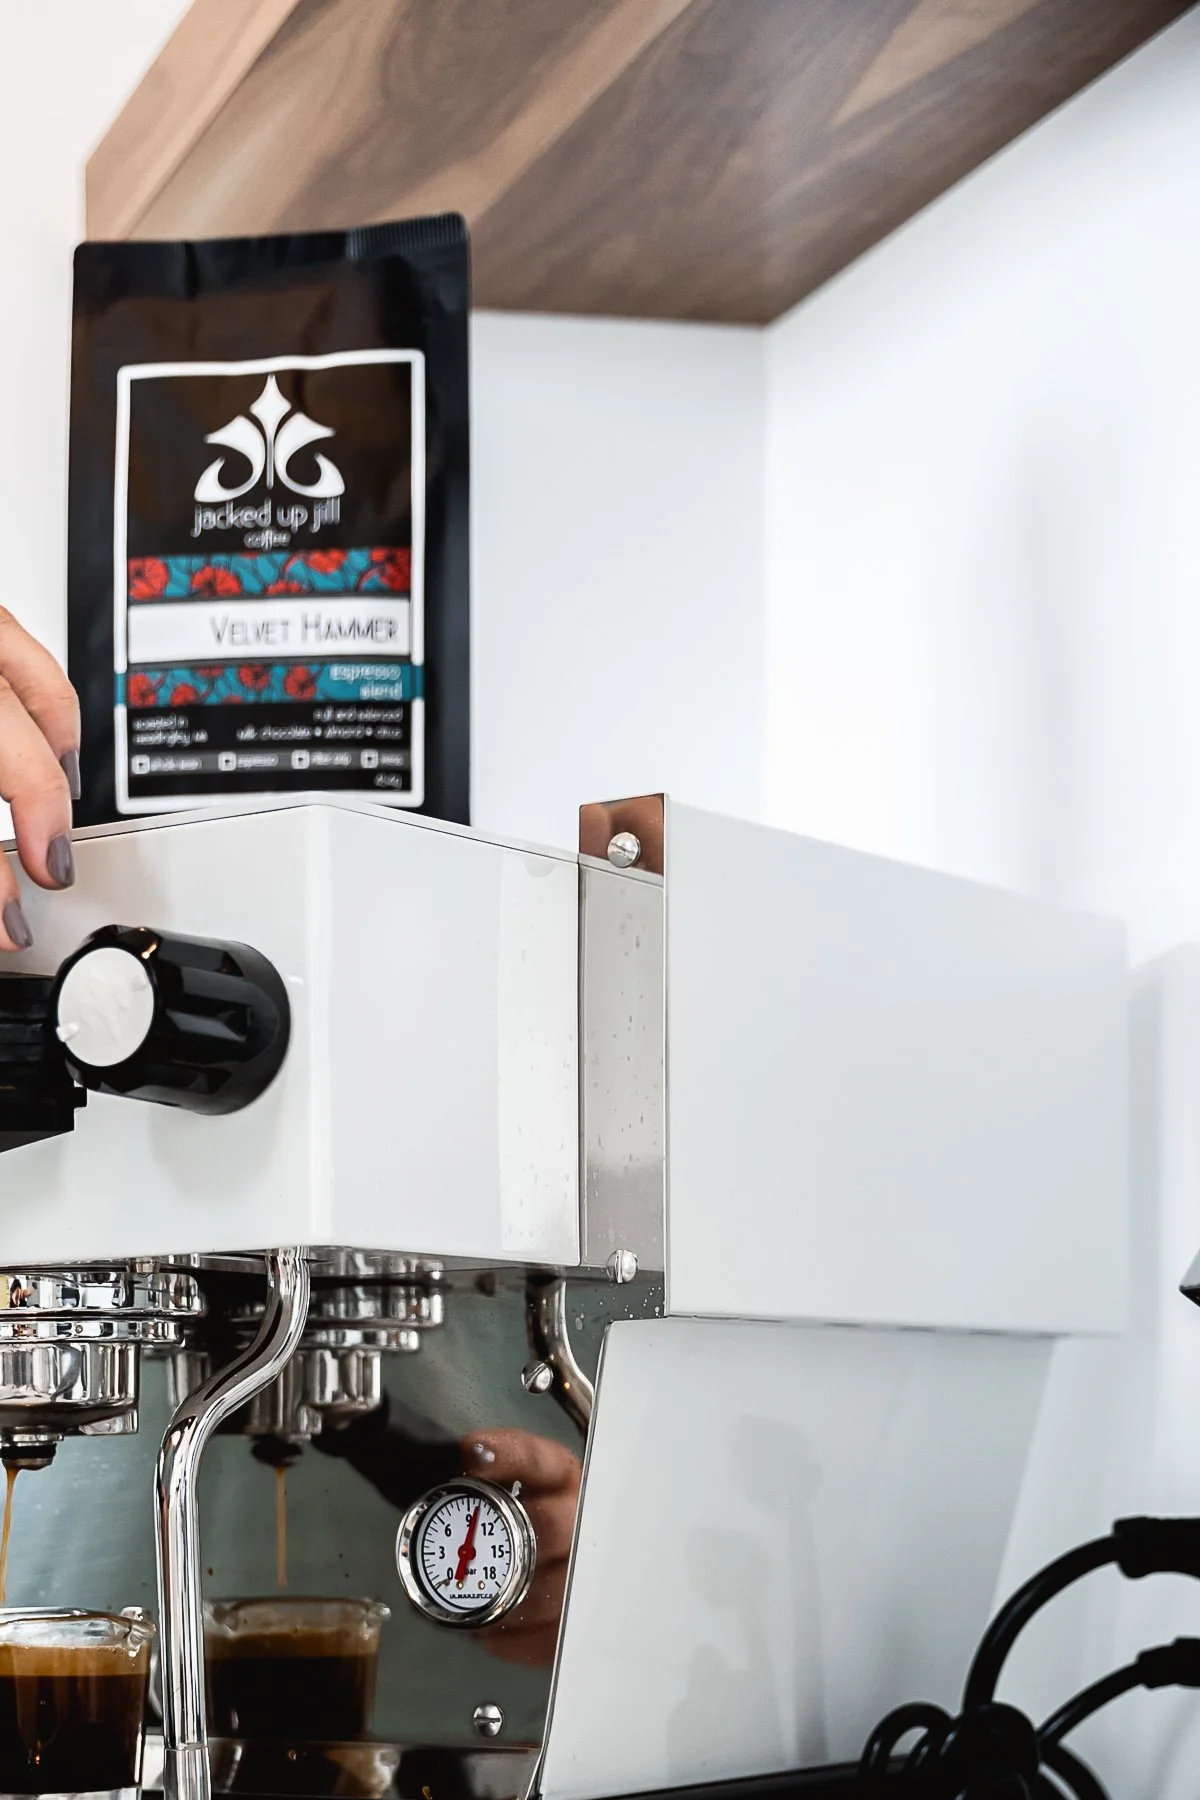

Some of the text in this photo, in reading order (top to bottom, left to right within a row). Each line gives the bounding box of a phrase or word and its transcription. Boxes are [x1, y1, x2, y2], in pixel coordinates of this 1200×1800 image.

[190, 497, 341, 538] jacked up jill
[210, 612, 399, 646] VELVET HAMMER
[445, 1524, 452, 1537] 6
[481, 1522, 495, 1536] 12
[439, 1546, 445, 1560] 3
[491, 1544, 505, 1559] 15
[447, 1567, 453, 1580] 0
[483, 1566, 497, 1580] 18
